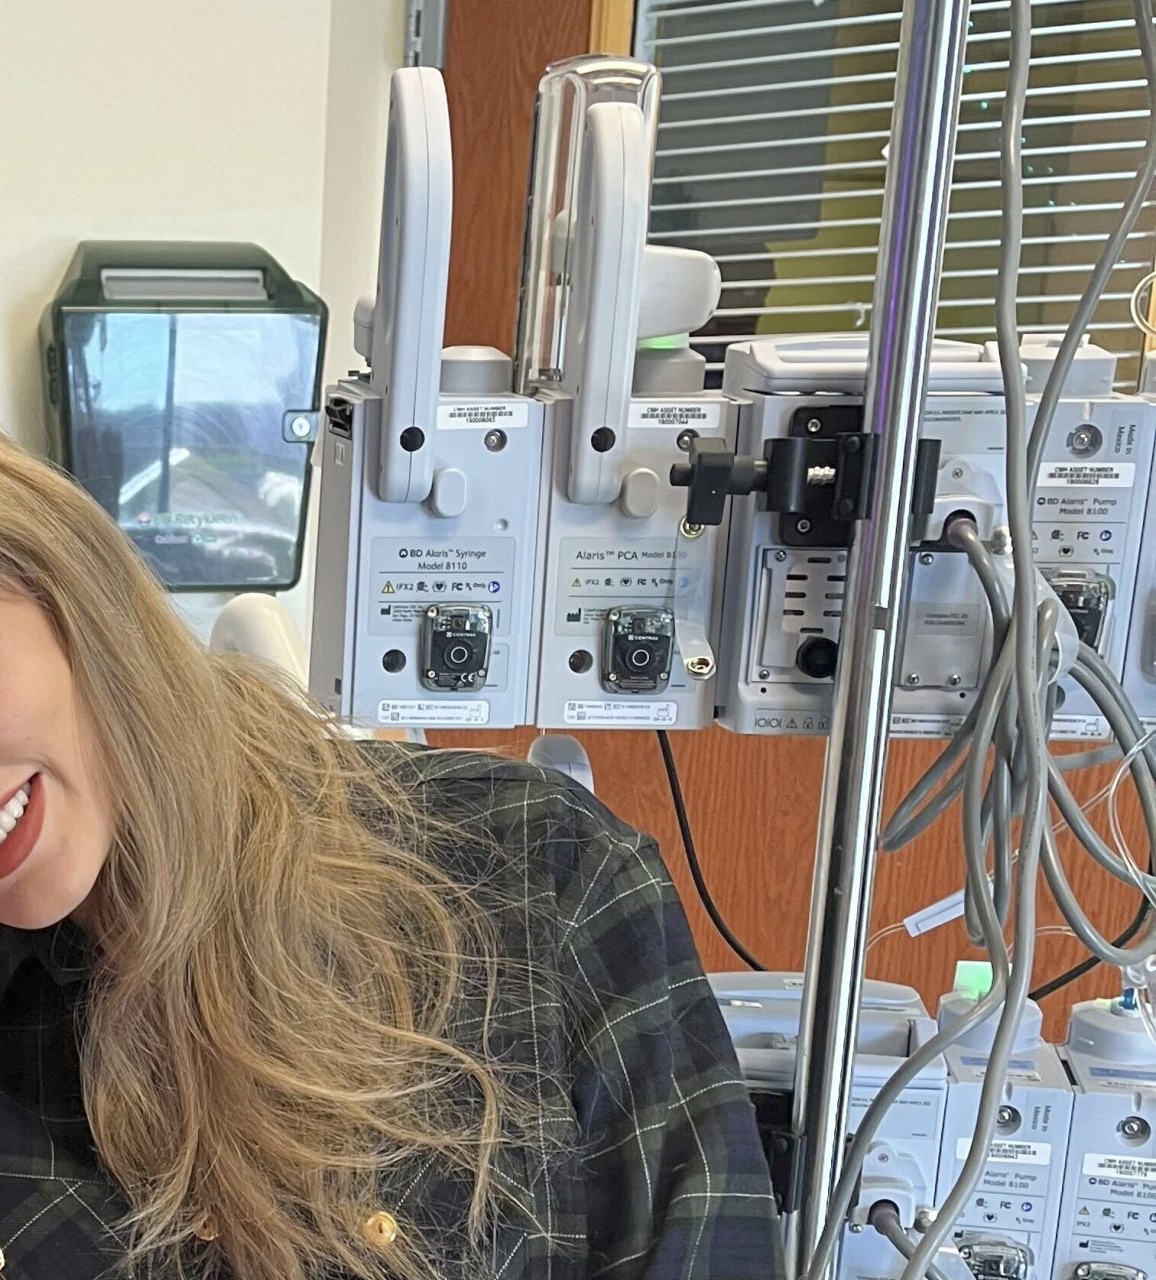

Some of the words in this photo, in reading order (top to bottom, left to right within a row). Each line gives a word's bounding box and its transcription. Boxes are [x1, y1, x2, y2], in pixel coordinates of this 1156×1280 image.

[1093, 498, 1117, 506] Pump
[409, 549, 423, 558] BD
[455, 549, 487, 560] Syringe
[617, 551, 638, 560] PCA
[641, 551, 664, 559] Model
[418, 562, 444, 570] Model
[445, 561, 468, 570] 8110
[1014, 1173, 1037, 1181] Pump
[1008, 1181, 1029, 1189] 8100
[1110, 1188, 1134, 1197] Model
